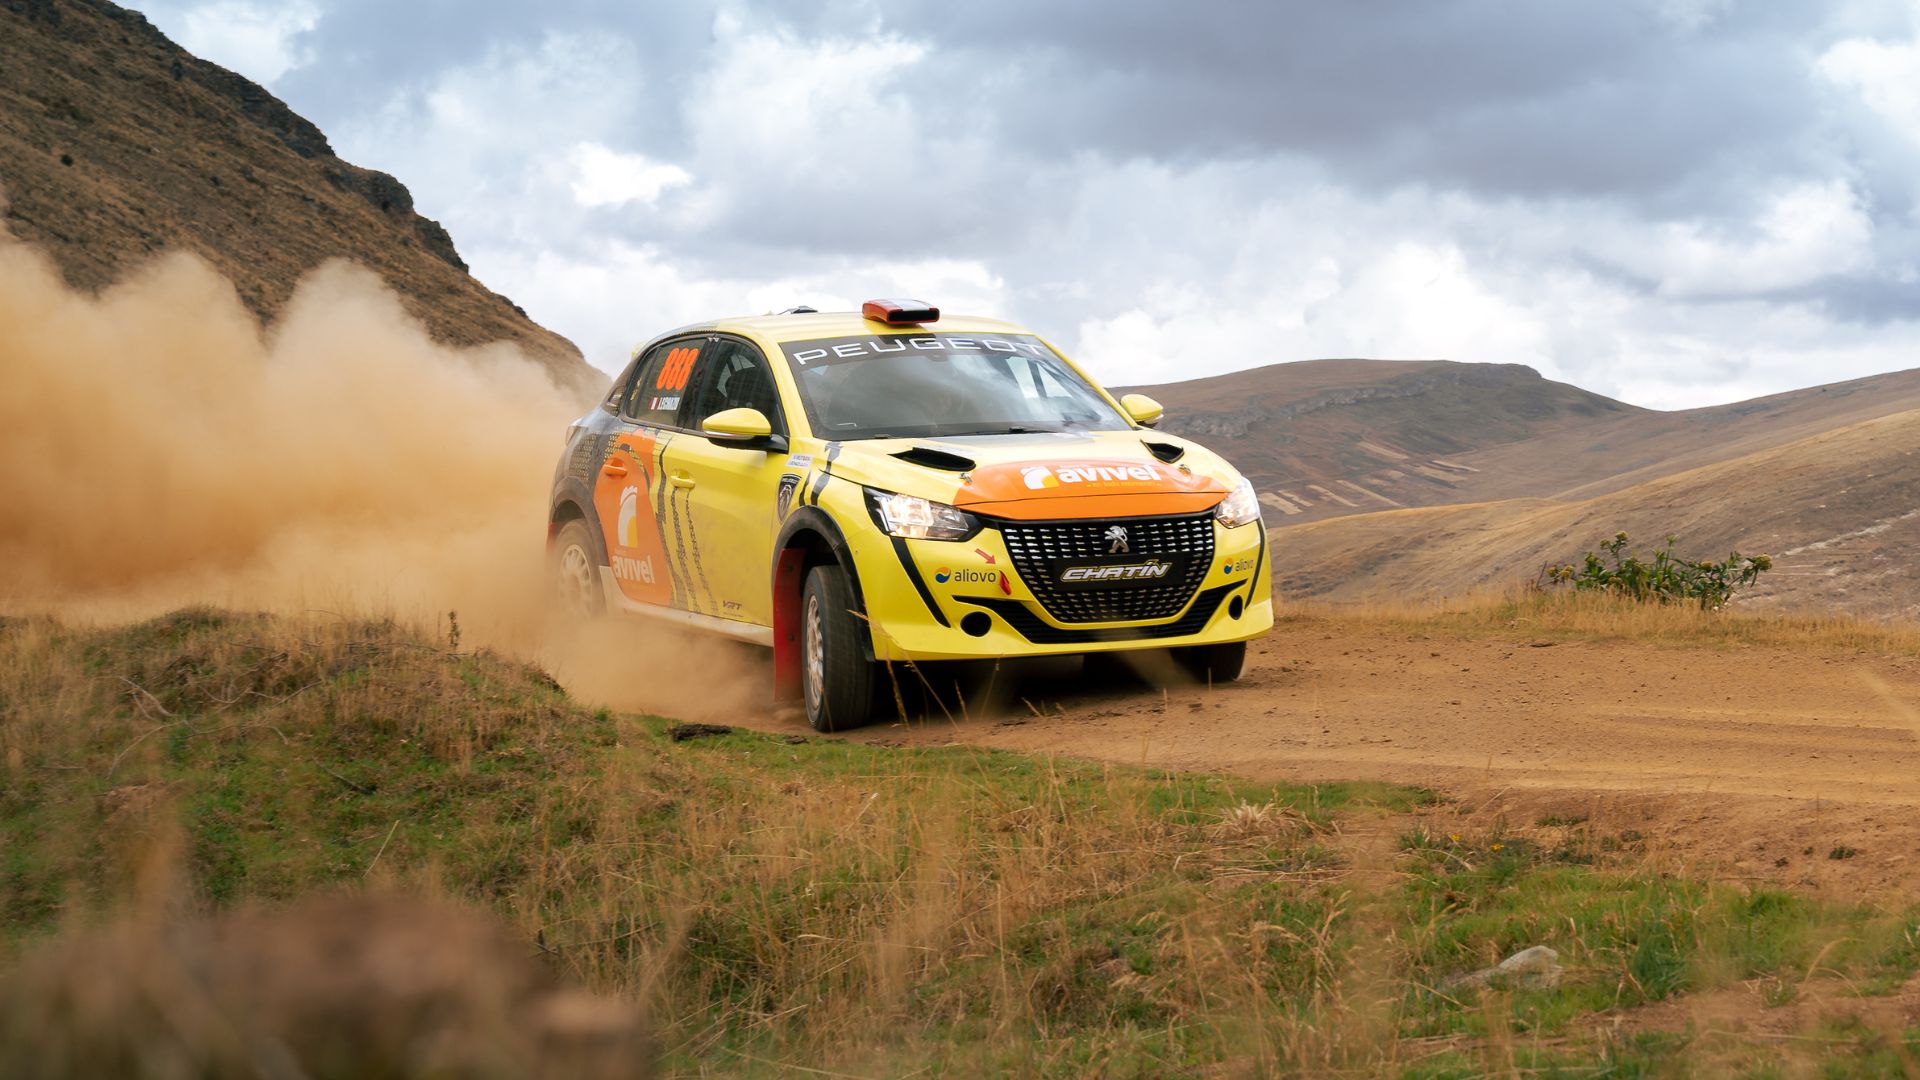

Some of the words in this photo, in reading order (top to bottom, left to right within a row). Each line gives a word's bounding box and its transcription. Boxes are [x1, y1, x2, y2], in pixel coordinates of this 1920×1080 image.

[793, 337, 1043, 365] PEUGEOT
[656, 348, 700, 390] 888
[1056, 465, 1162, 483] avivel
[612, 555, 655, 584] avivel
[954, 569, 996, 583] aliovo
[1060, 559, 1172, 582] CHATÍN
